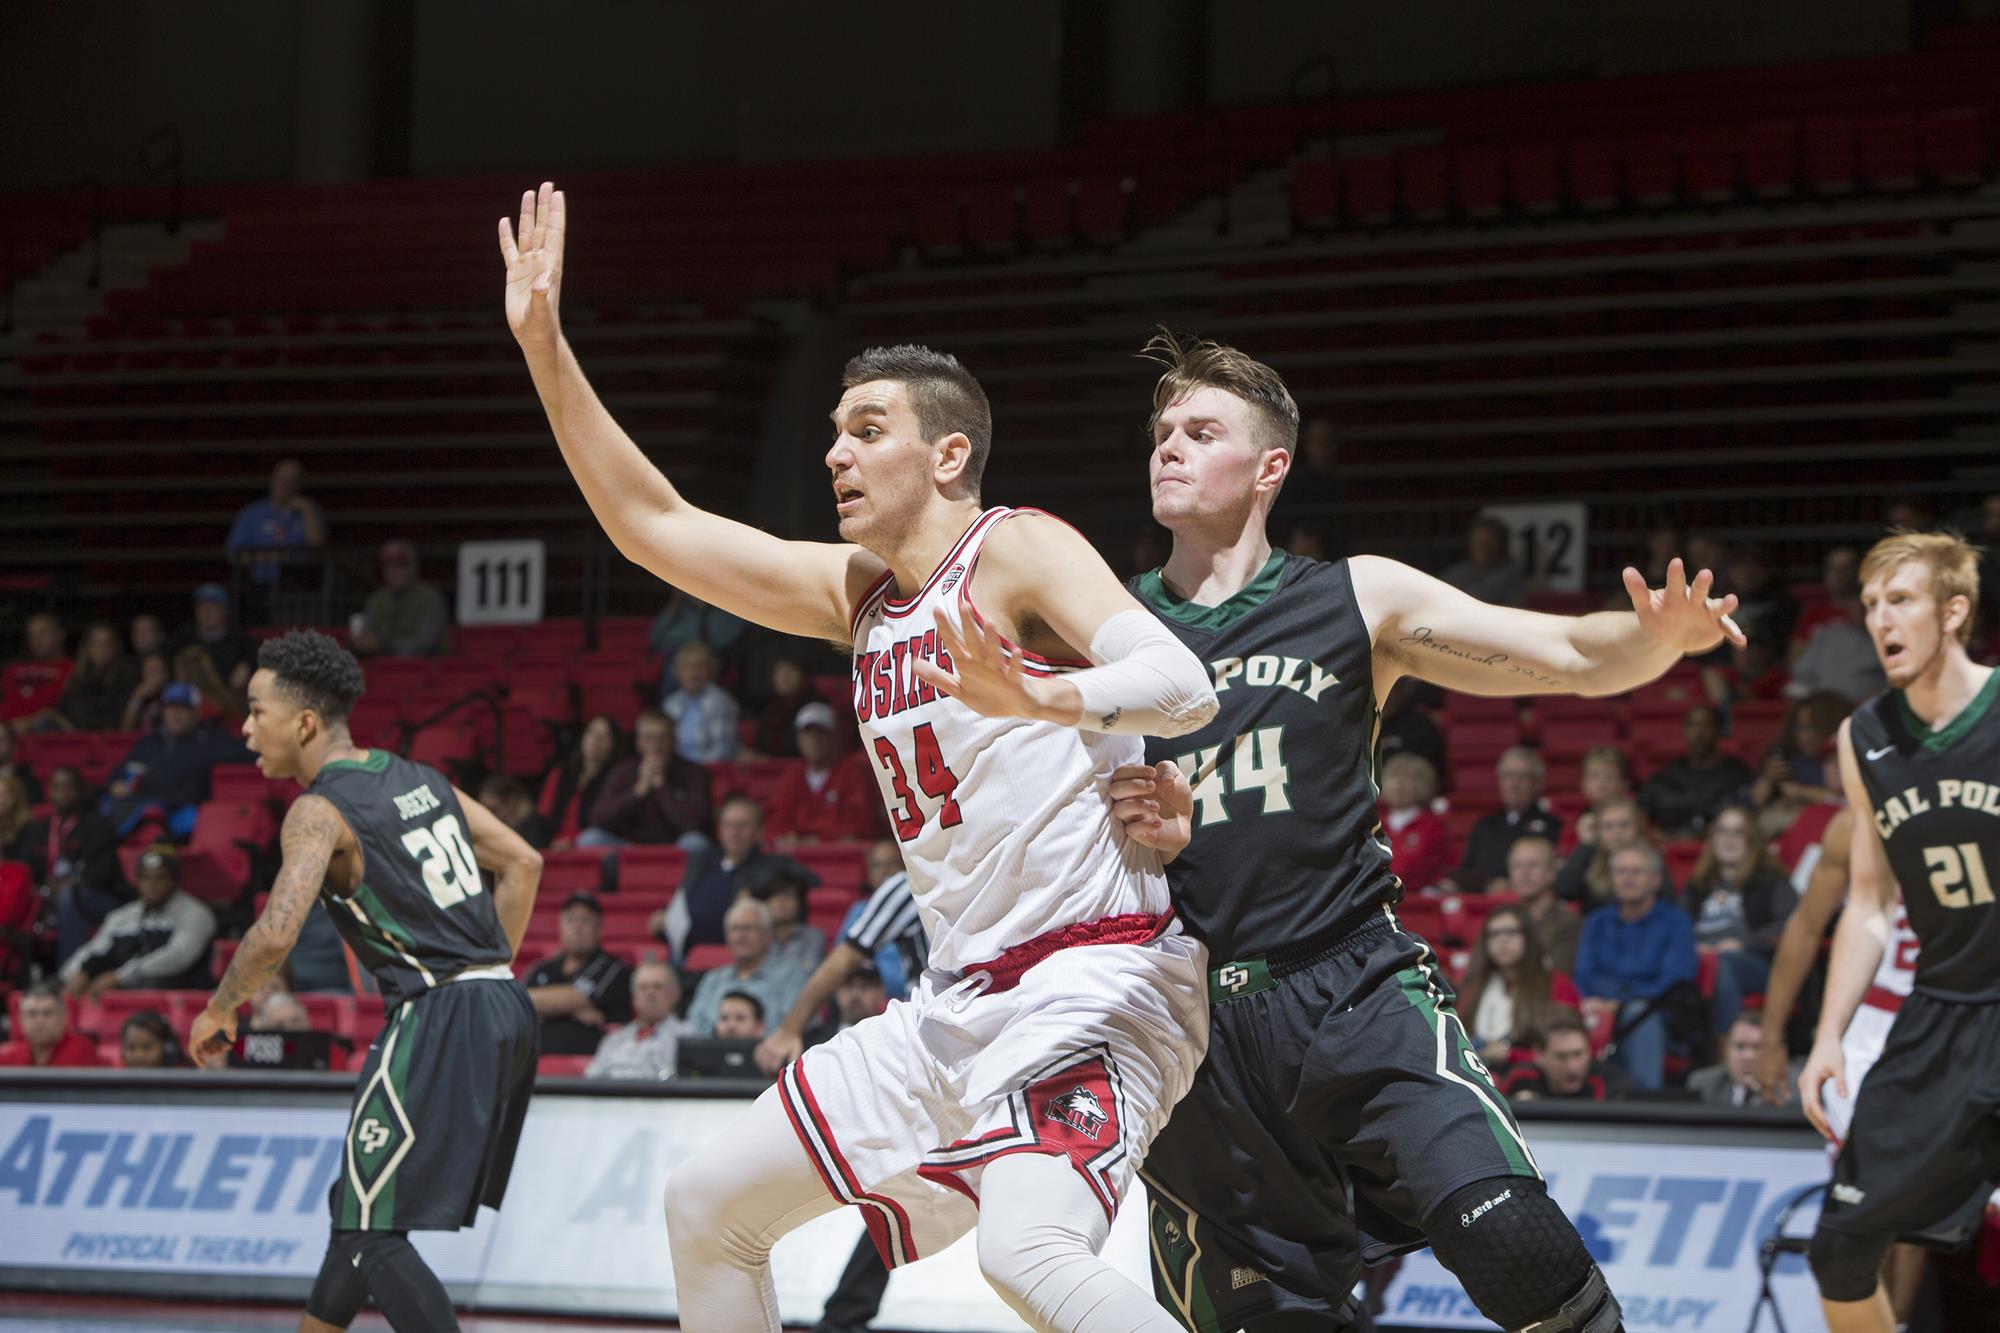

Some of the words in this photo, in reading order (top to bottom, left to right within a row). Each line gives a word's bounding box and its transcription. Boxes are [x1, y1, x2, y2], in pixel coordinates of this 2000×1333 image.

[1519, 520, 1572, 576] 12
[471, 559, 530, 609] 111
[853, 628, 955, 724] USKIES
[1399, 627, 1508, 666] Jeremiah
[1210, 655, 1340, 703] POLY
[873, 722, 963, 843] 34
[1175, 724, 1294, 829] 44
[1874, 786, 1930, 840] CAL
[1937, 779, 2000, 816] POL
[401, 813, 483, 910] 20
[1923, 842, 1996, 909] 21
[0, 1115, 346, 1214] ATHLETI
[358, 1118, 390, 1154] CP
[62, 1231, 179, 1262] PHYSICAL
[186, 1234, 301, 1267] THERAPY
